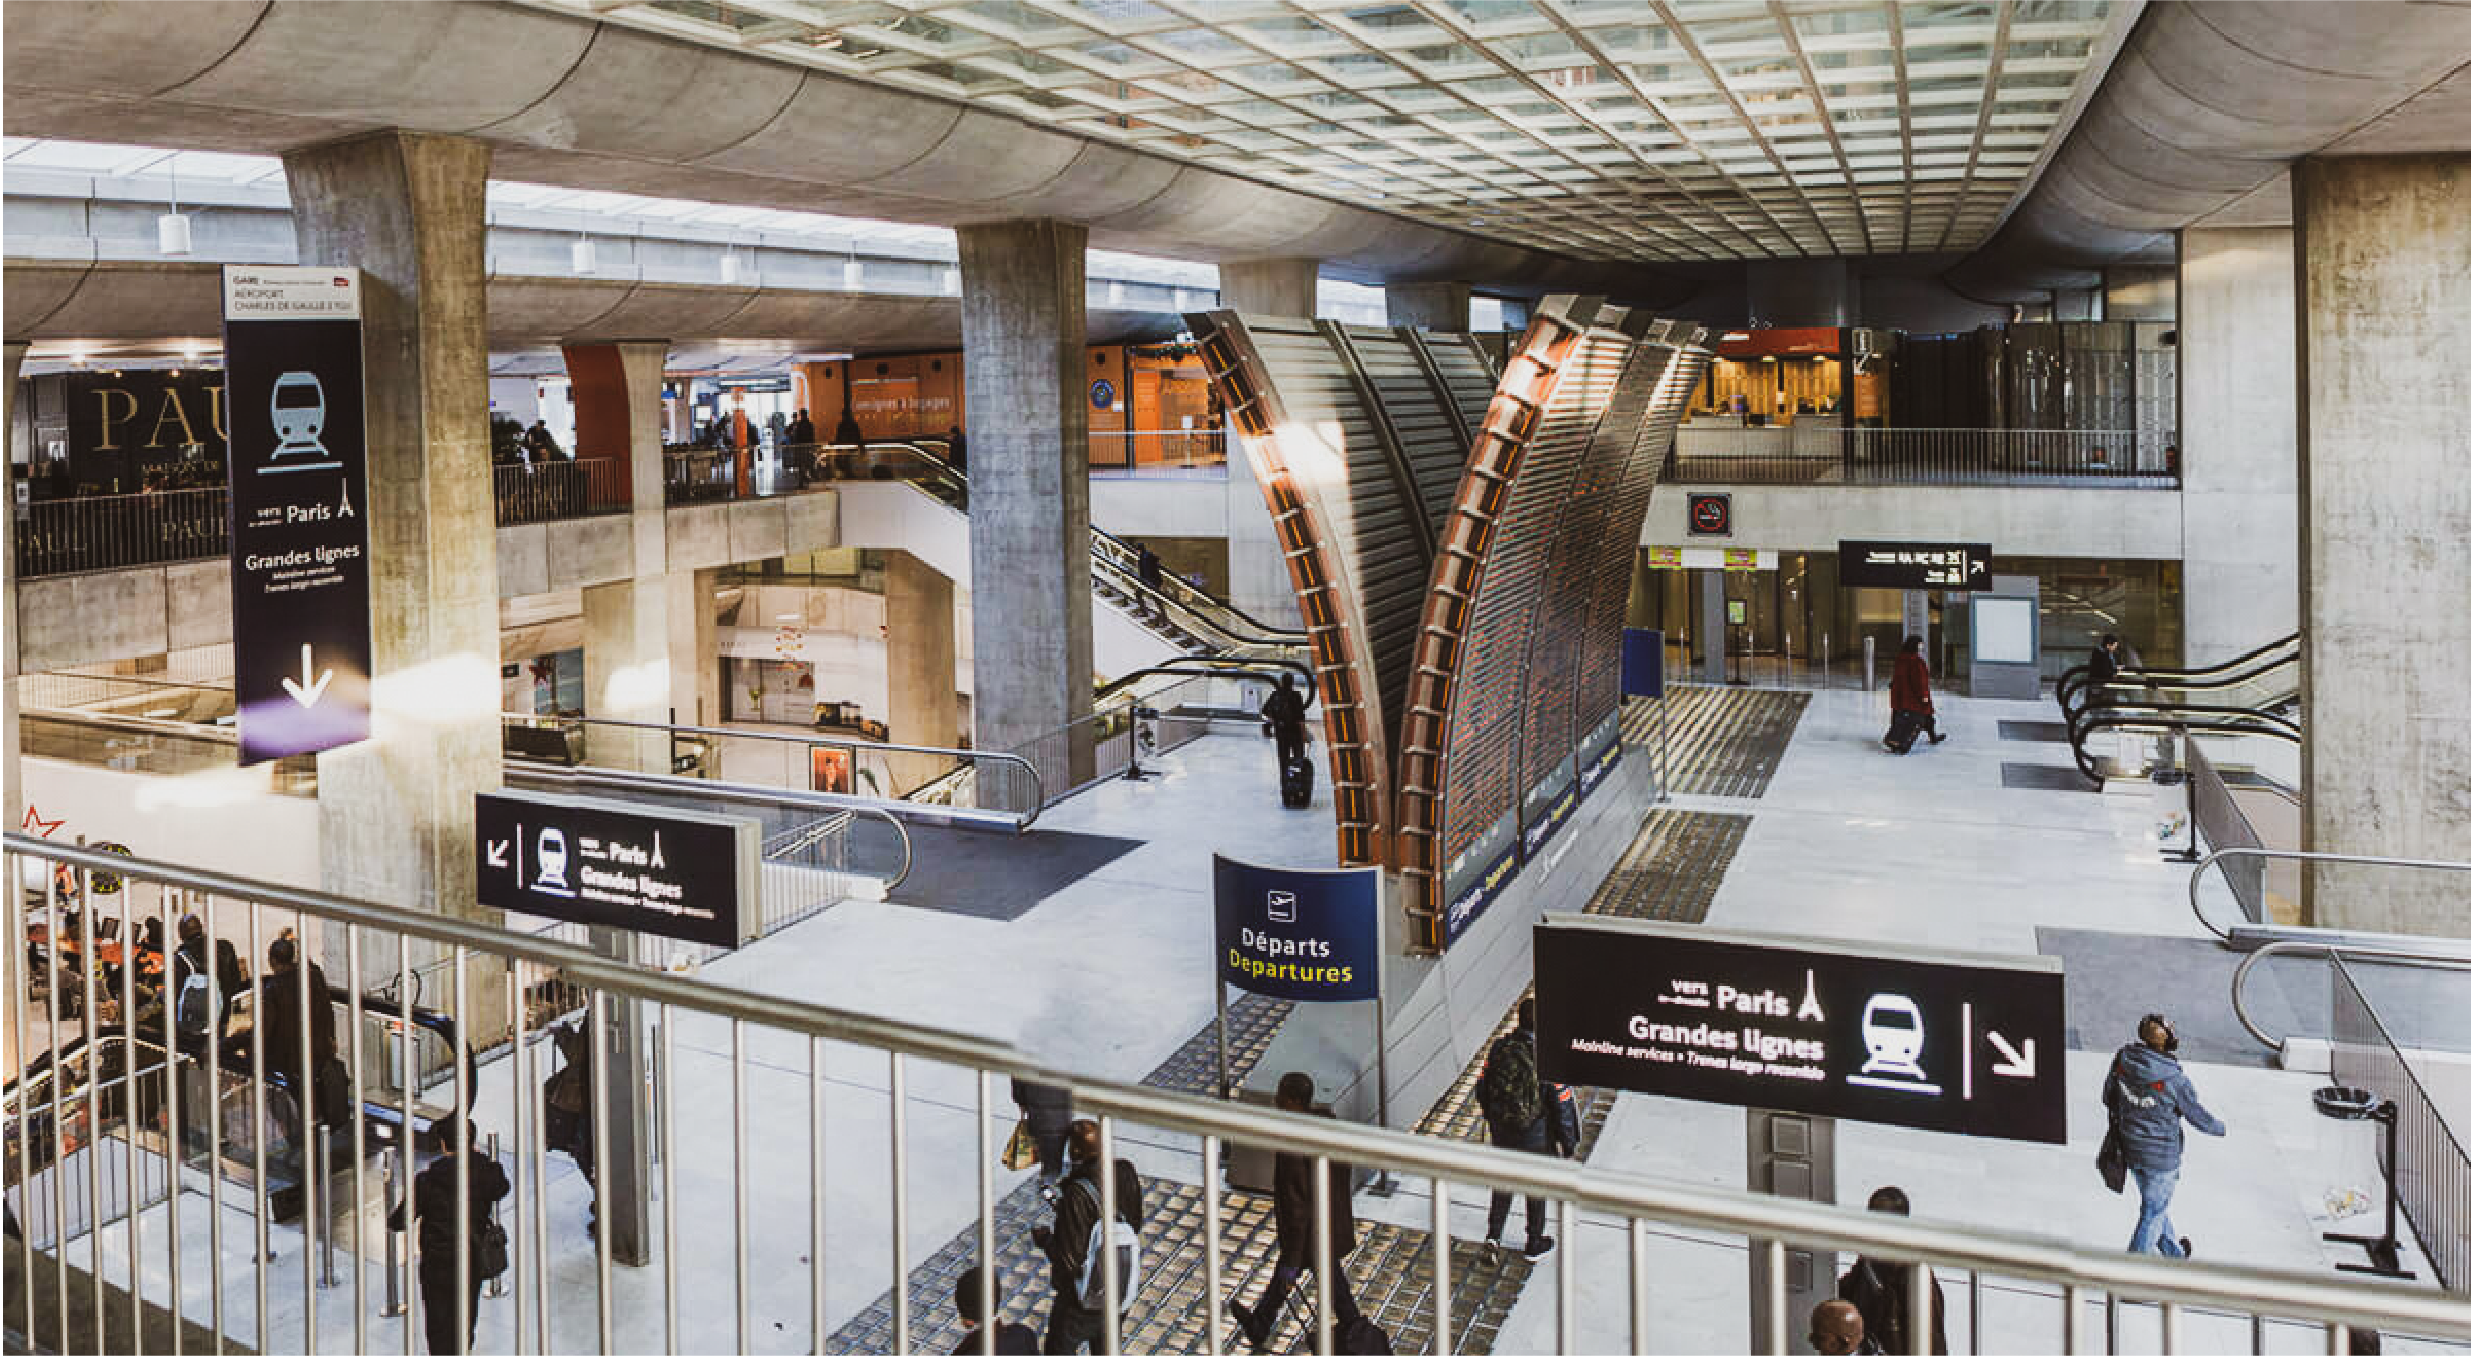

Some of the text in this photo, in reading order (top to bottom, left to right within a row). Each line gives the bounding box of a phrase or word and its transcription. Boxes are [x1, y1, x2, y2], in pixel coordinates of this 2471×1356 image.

[286, 502, 331, 524] Paris
[245, 544, 361, 571] Grandes lignes
[1242, 926, 1331, 959] Départs
[1228, 947, 1354, 984] Departures
[1716, 984, 1791, 1018] Paris
[1627, 1014, 1826, 1062] Grandes lignes
